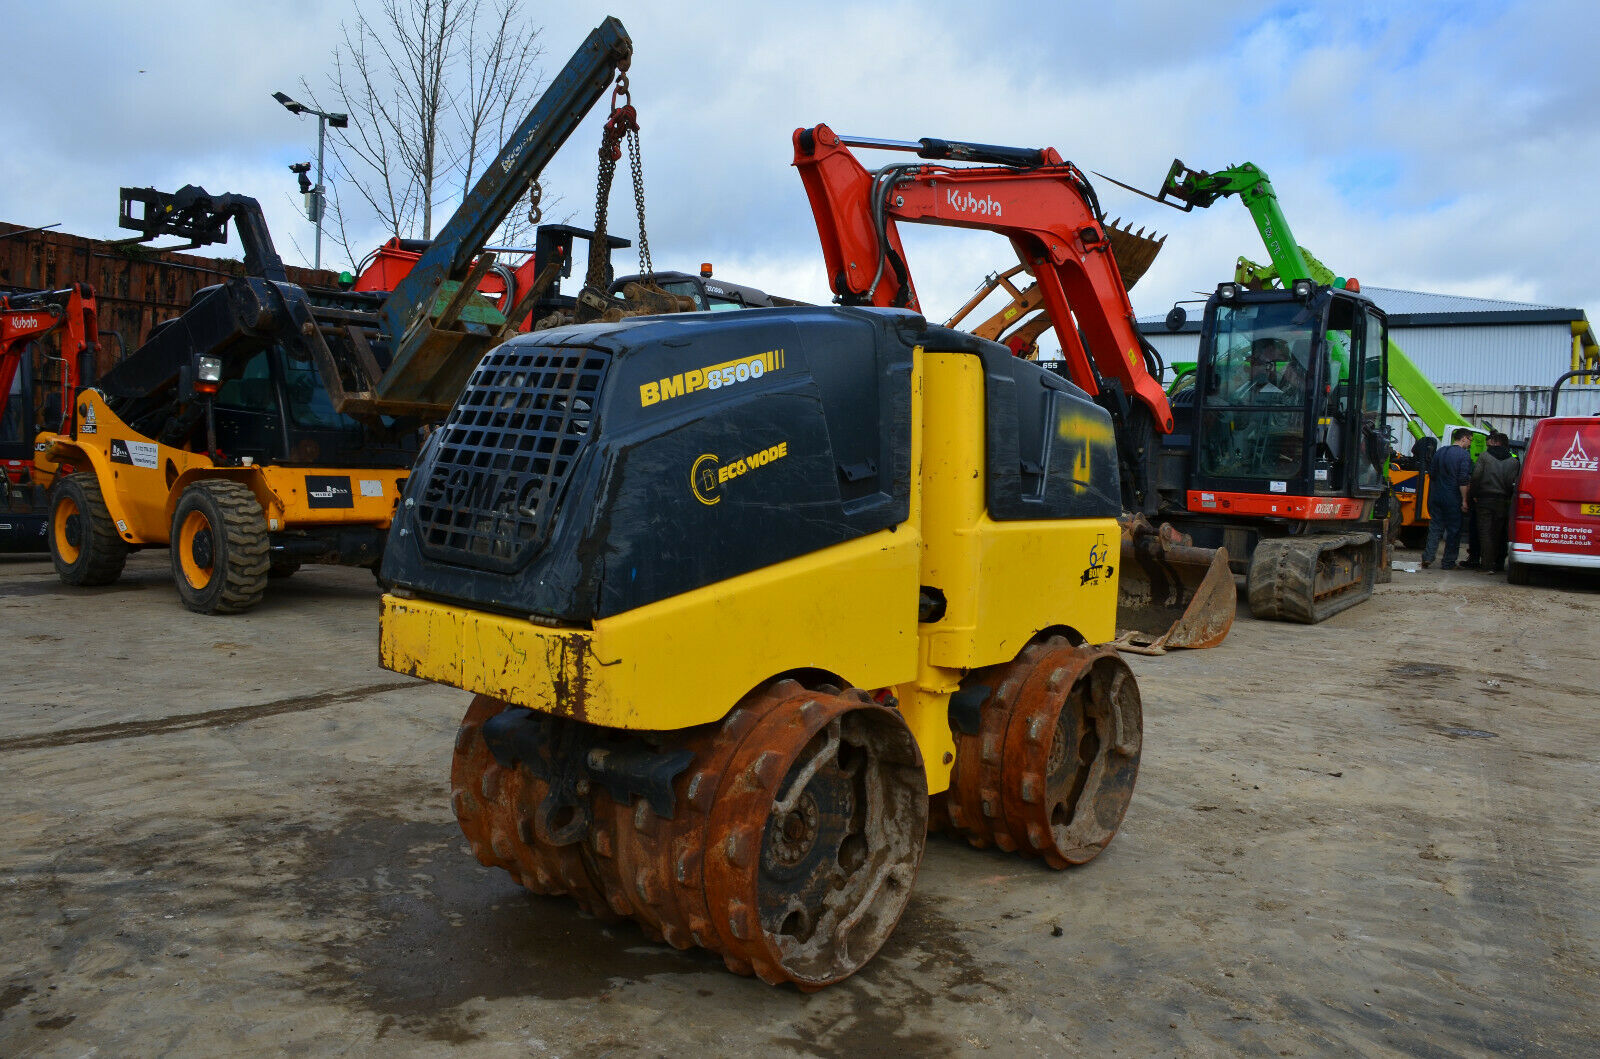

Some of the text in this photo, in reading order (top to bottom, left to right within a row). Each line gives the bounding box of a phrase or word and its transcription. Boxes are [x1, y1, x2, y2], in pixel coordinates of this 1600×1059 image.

[947, 188, 1002, 217] Kubota
[12, 316, 38, 329] Kubota
[639, 358, 765, 408] BMP 8500
[34, 443, 46, 452] JC
[718, 441, 788, 484] ECO MODE
[1551, 460, 1598, 469] DEUTZ
